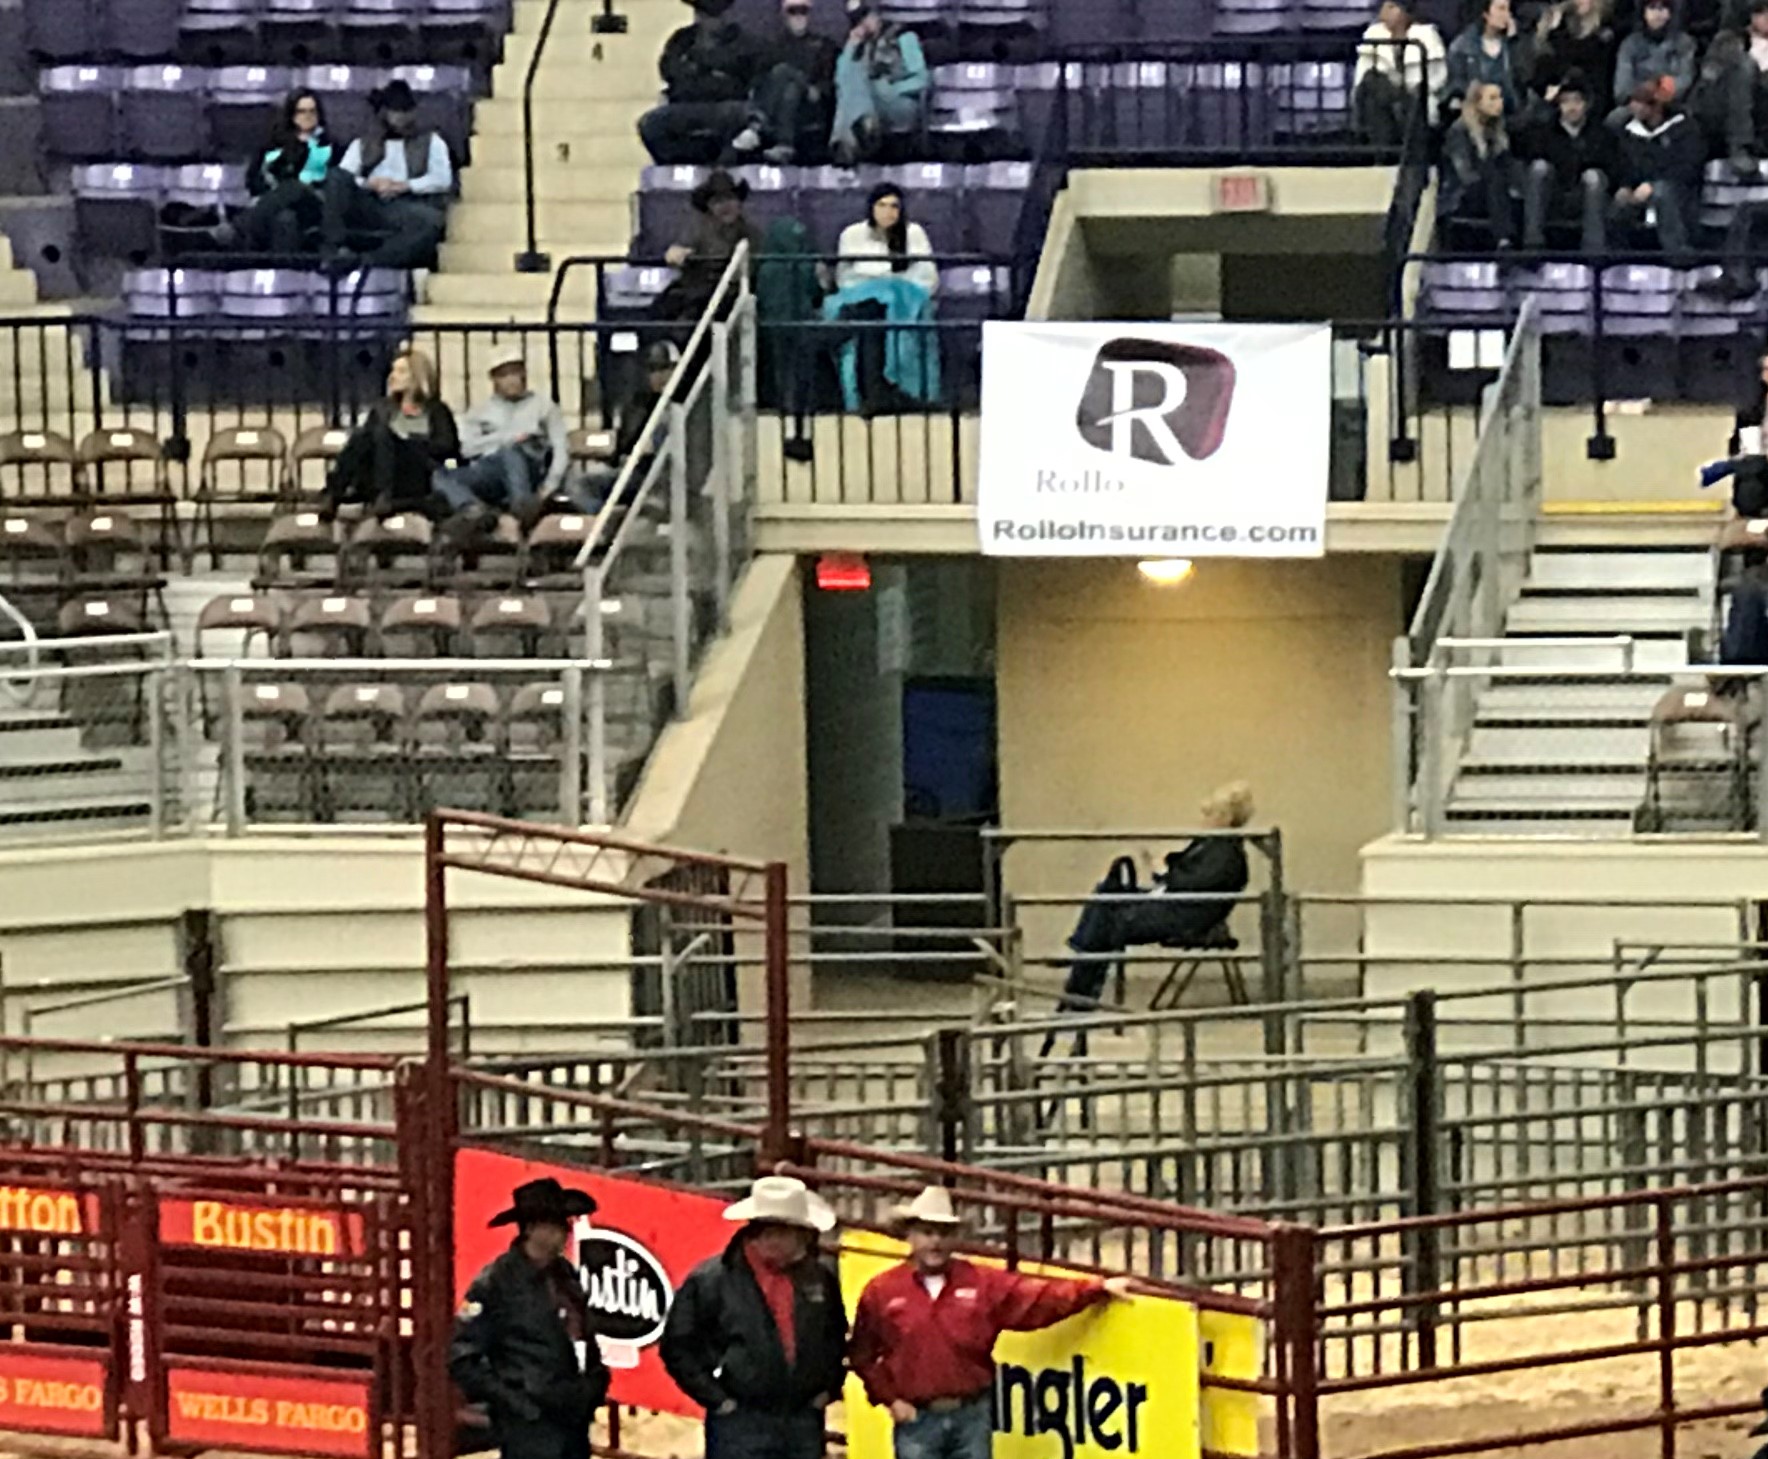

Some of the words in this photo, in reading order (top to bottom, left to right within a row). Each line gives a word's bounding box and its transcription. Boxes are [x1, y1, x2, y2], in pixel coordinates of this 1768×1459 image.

[1036, 469, 1125, 493] Rollo
[993, 519, 1317, 543] RolloInsurance.com
[0, 1186, 83, 1234] tton
[194, 1201, 336, 1254] Bustin
[579, 1248, 661, 1322] ustin
[14, 1378, 102, 1410] FARGO
[177, 1391, 268, 1425] WELLS
[276, 1400, 367, 1433] FARGO
